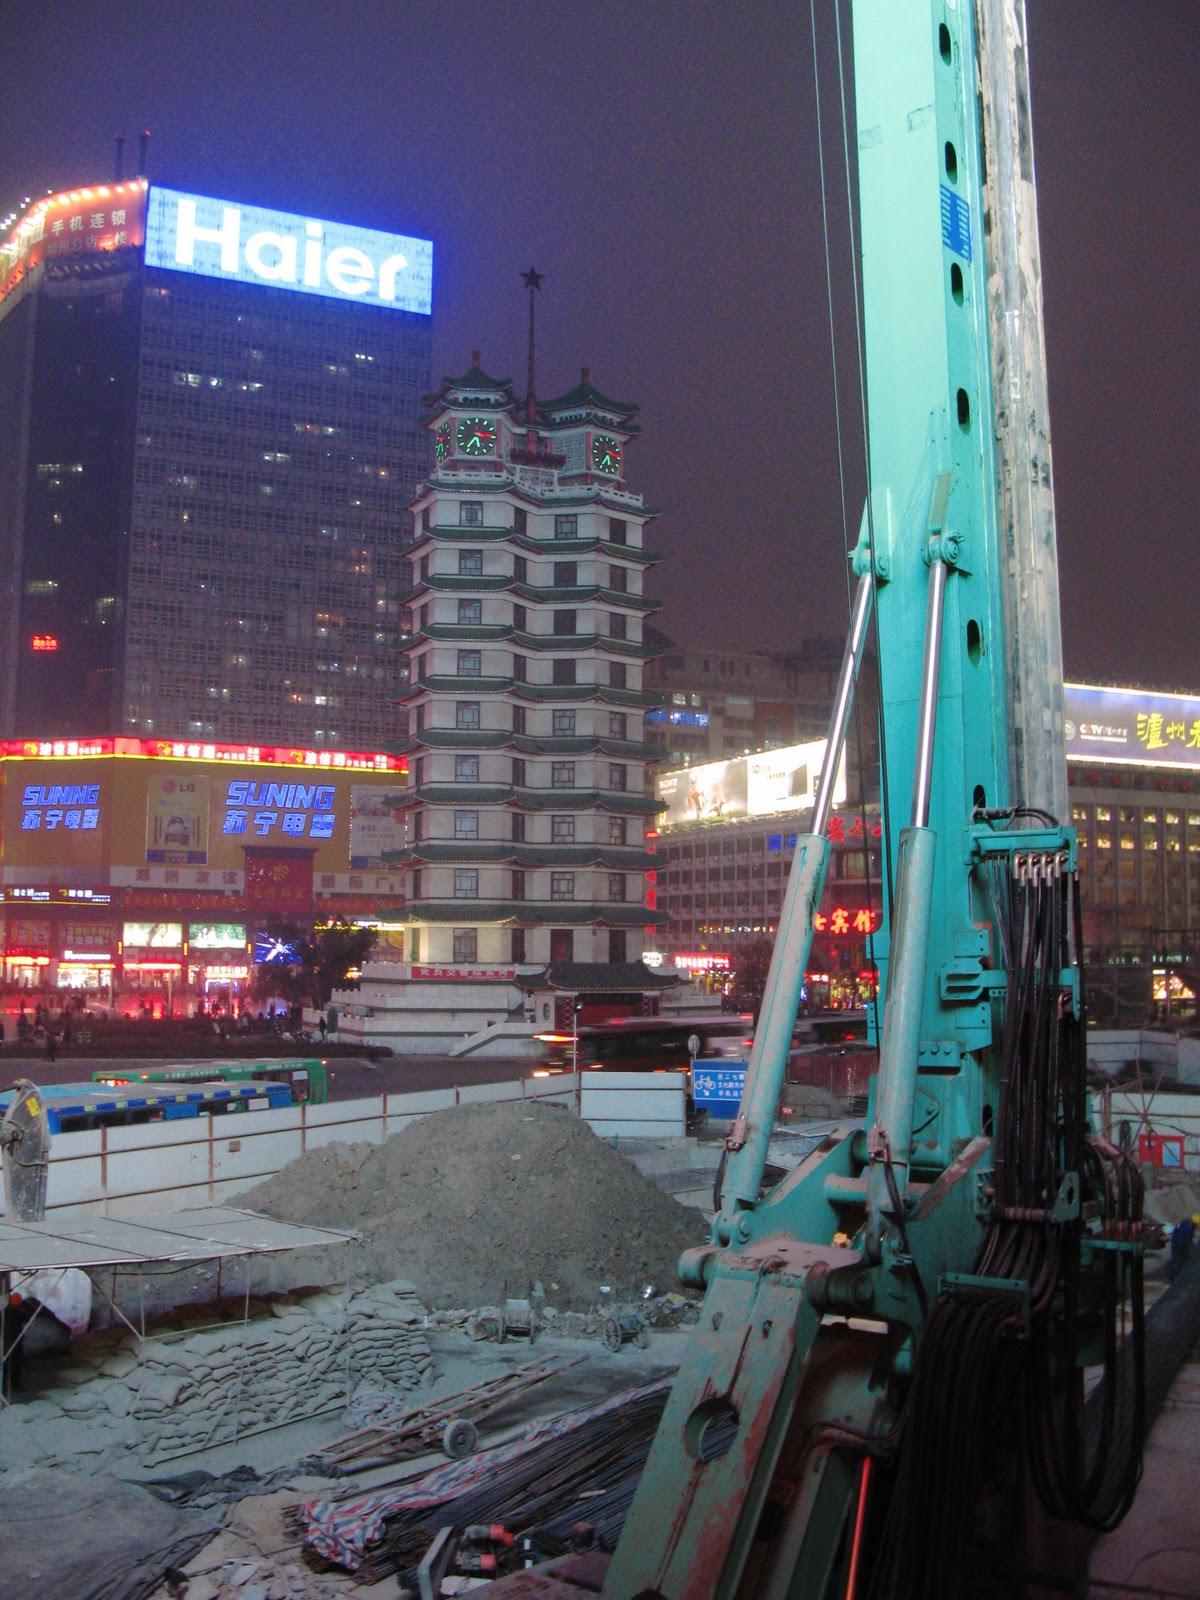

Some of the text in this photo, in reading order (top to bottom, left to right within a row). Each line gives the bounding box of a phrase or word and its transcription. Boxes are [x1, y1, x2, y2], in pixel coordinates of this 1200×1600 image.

[51, 209, 126, 236] 手机连锁
[175, 198, 409, 301] Haier
[22, 785, 100, 805] SUNING
[179, 783, 196, 793] LG
[225, 780, 336, 810] SUNING
[659, 778, 678, 789] SONY
[22, 808, 99, 829] 苏宁电器
[222, 810, 336, 838] 苏宁电器
